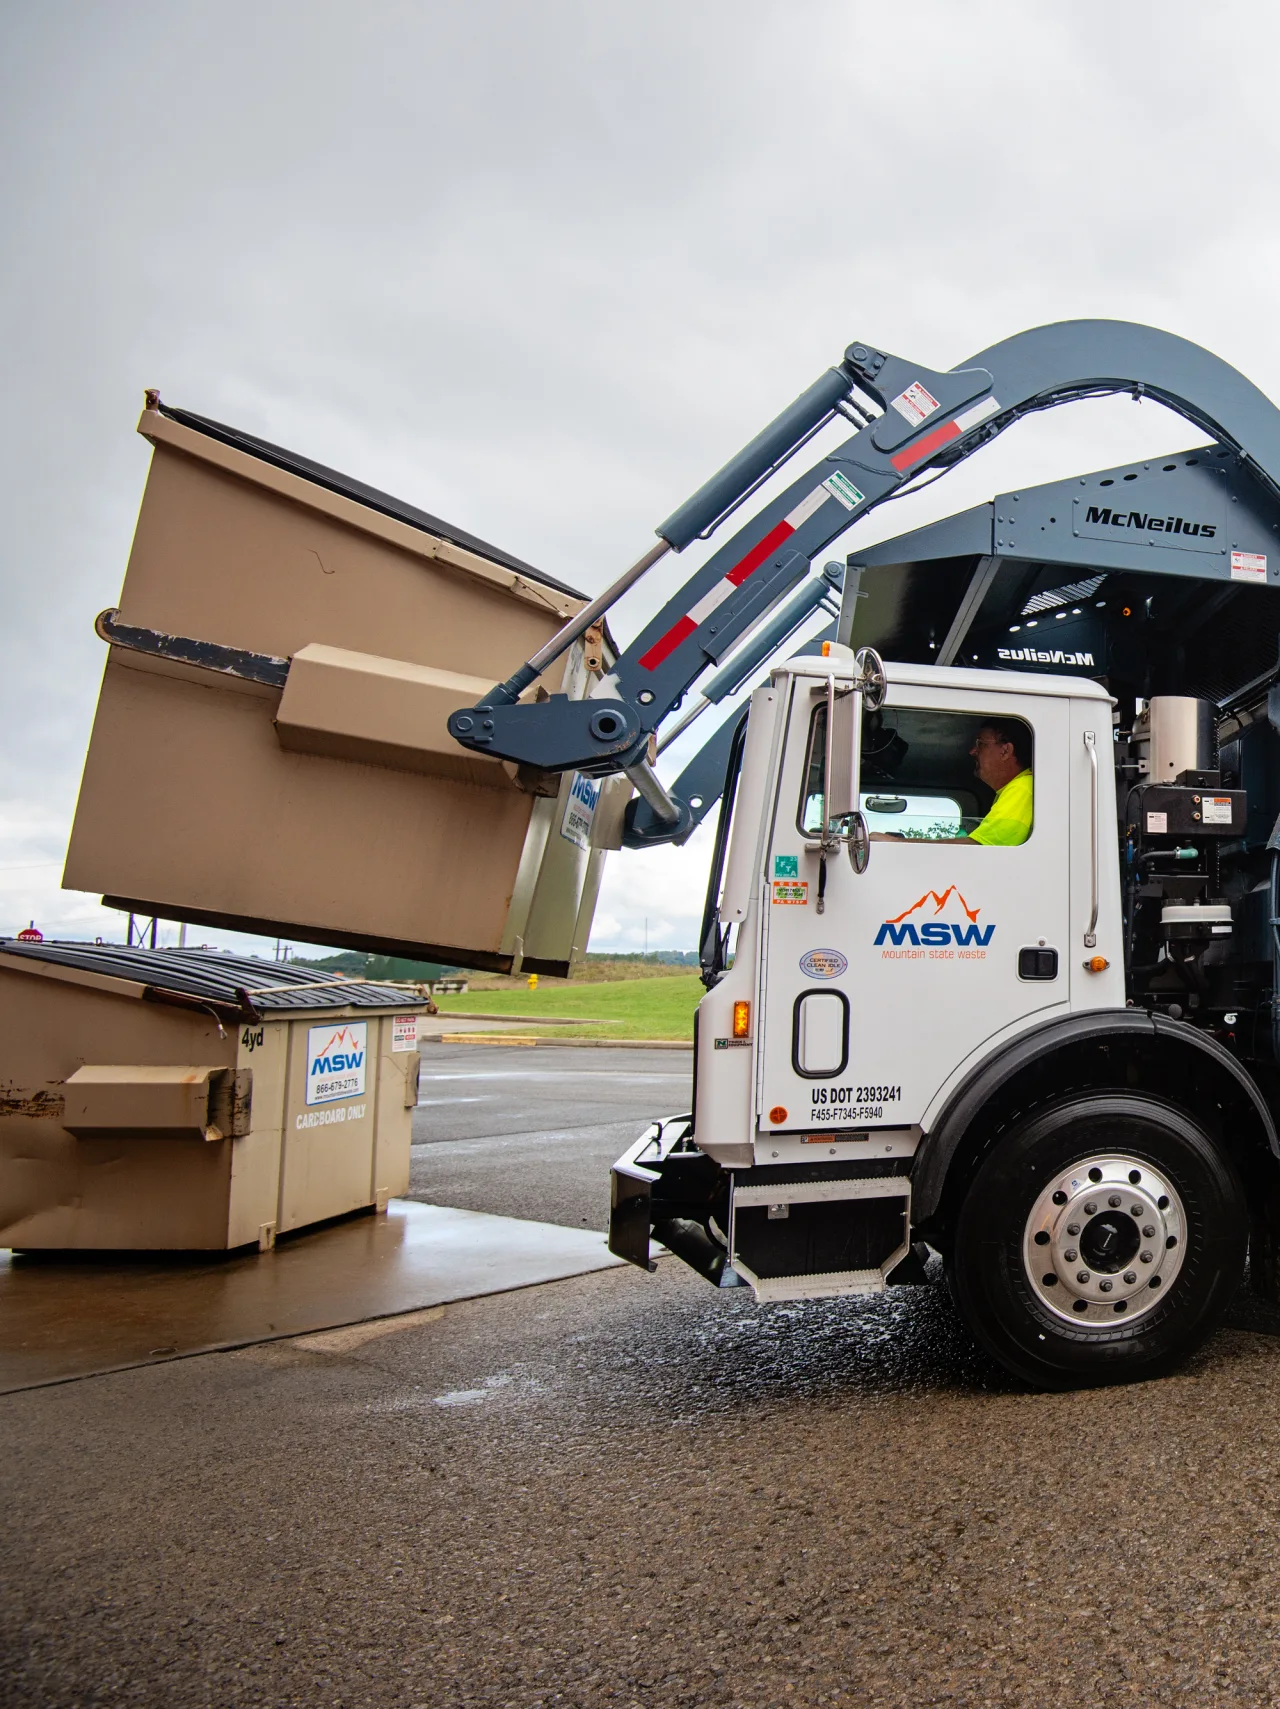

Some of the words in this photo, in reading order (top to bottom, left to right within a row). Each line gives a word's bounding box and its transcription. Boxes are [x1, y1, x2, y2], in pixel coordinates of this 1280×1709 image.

[1085, 506, 1217, 538] McNeilus
[571, 774, 601, 812] MSW
[873, 922, 997, 947] MSW
[929, 949, 955, 959] state
[957, 949, 987, 960] waste
[241, 1027, 264, 1052] 4yd
[311, 1052, 364, 1076] MSW
[316, 1078, 359, 1094] 866-679-2776
[811, 1088, 828, 1105] US
[829, 1087, 853, 1104] DOT
[856, 1085, 901, 1103] 2393241
[296, 1108, 346, 1130] CARDBOARD
[347, 1104, 367, 1120] ONLY
[810, 1106, 883, 1121] F455-F7345-F5940
